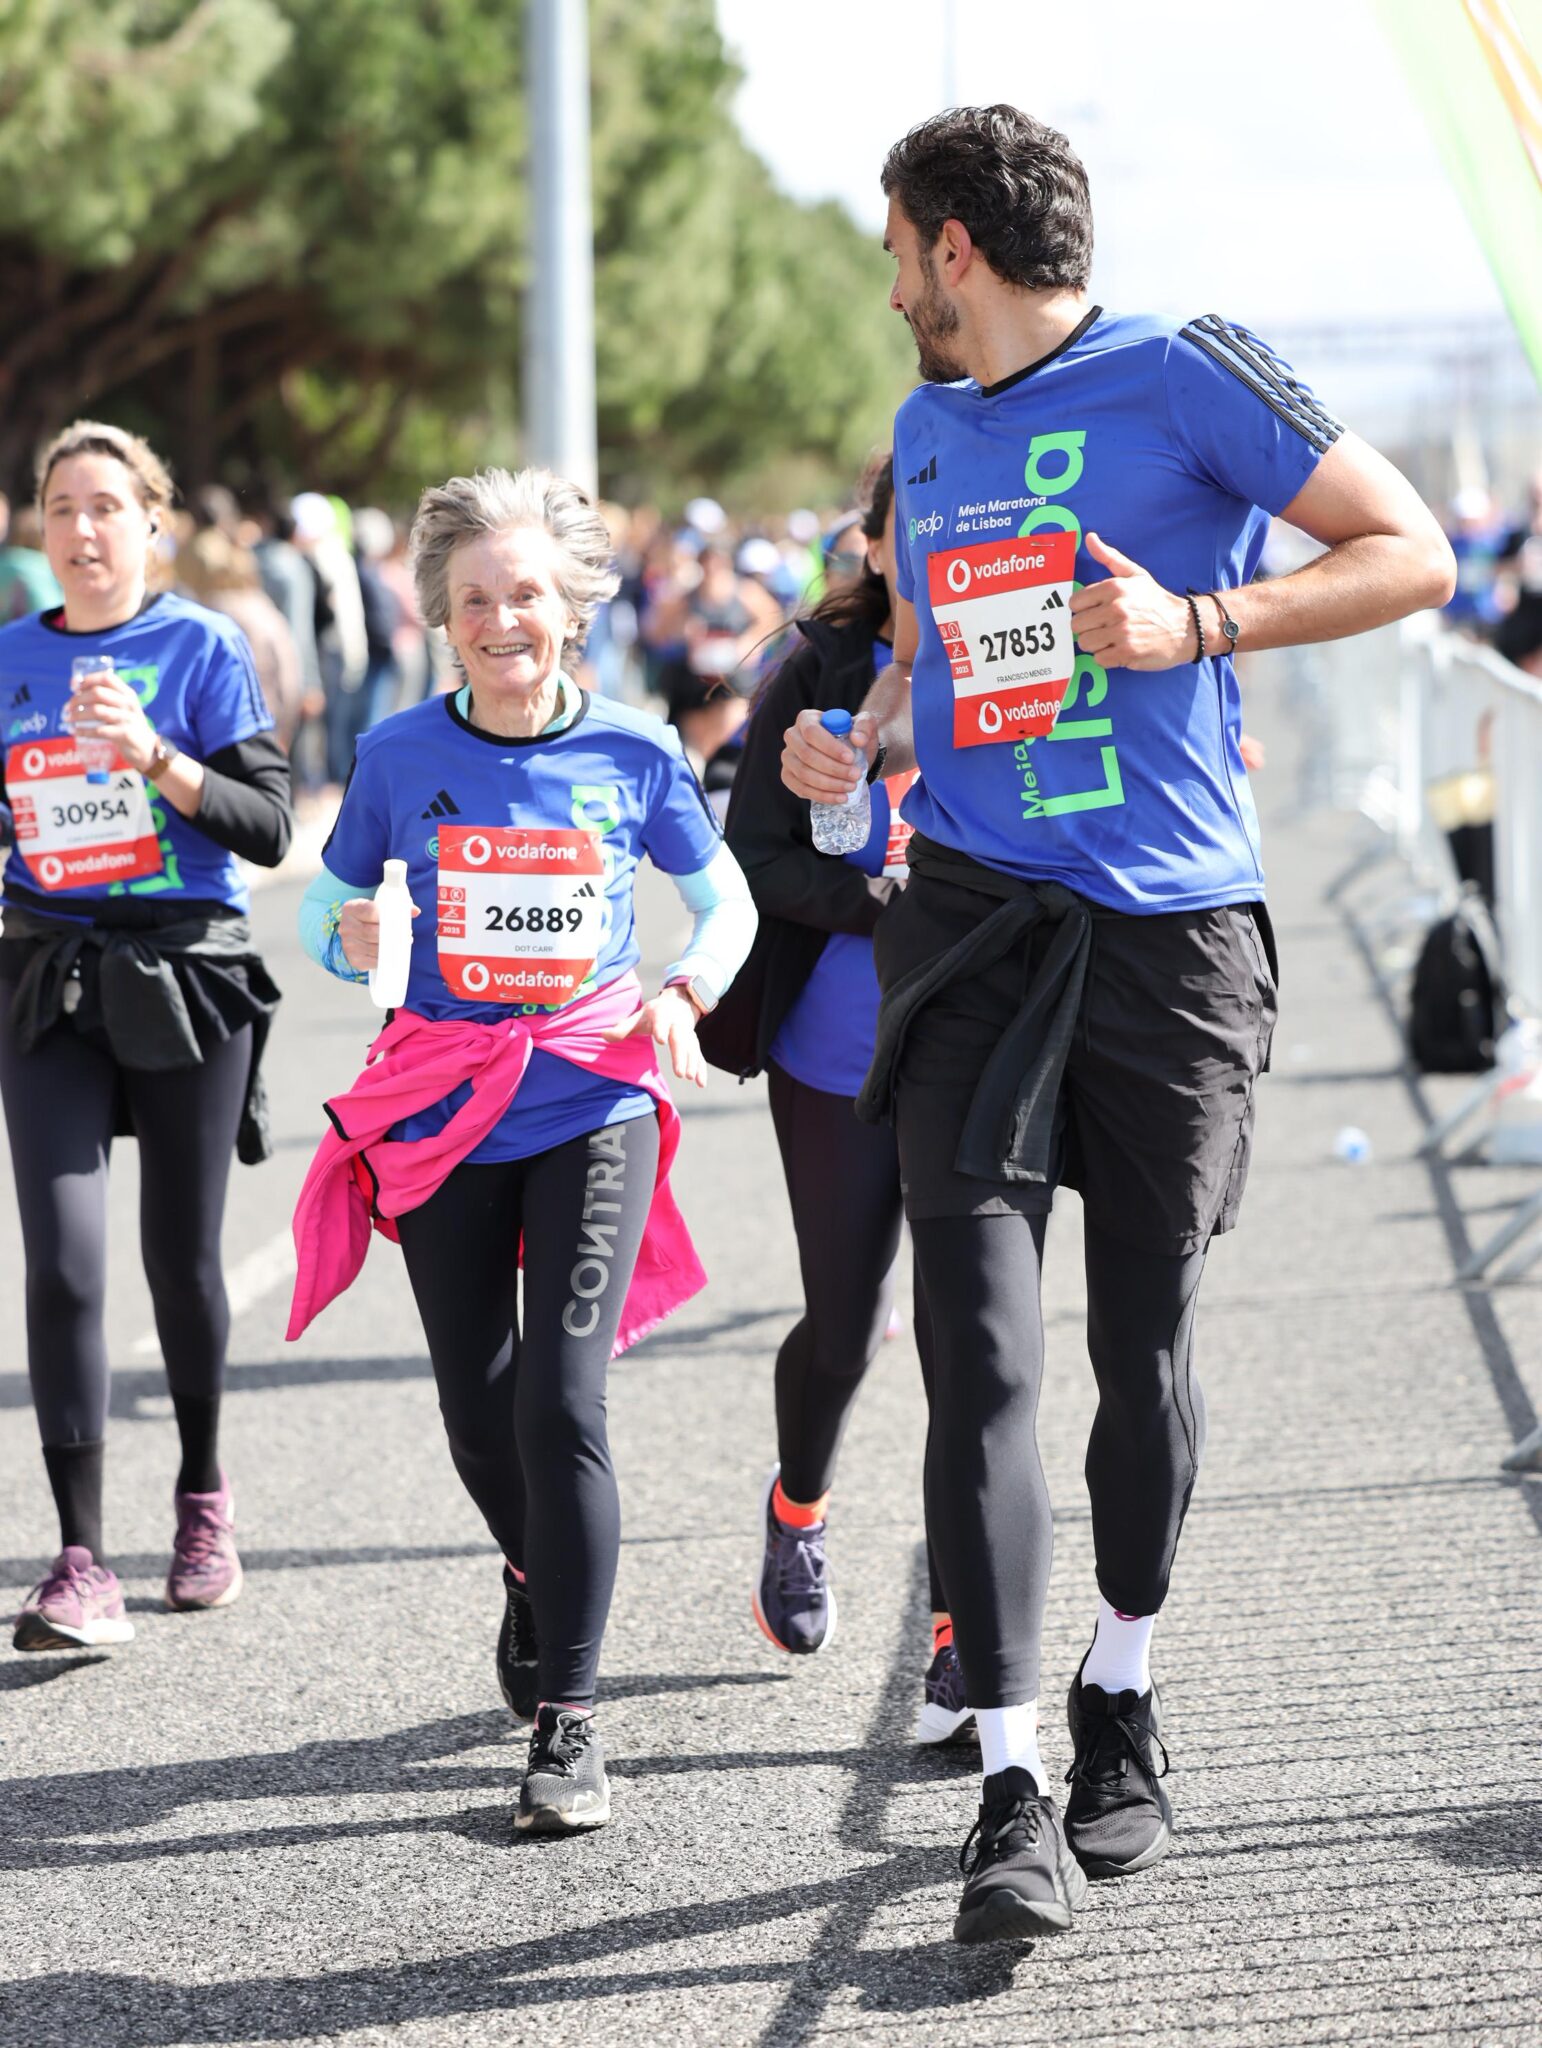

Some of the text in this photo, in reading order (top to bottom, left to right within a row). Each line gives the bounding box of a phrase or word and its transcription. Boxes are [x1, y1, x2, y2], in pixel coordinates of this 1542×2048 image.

[958, 496, 1047, 518] Meia Maratona
[917, 510, 944, 537] edp
[956, 516, 1012, 533] de Lisboa
[974, 554, 1046, 579] vodafone
[979, 622, 1056, 663] 27853
[955, 666, 969, 675] 2025
[997, 667, 1053, 684] FRANCISCO MENDES
[1004, 698, 1061, 721] vodafone
[1014, 744, 1046, 820] Meia
[52, 798, 130, 828] 30954
[496, 842, 577, 860] vodafone
[65, 852, 137, 875] vodafone
[484, 905, 583, 933] 26889
[532, 945, 553, 953] CARR
[493, 970, 574, 988] vodafone
